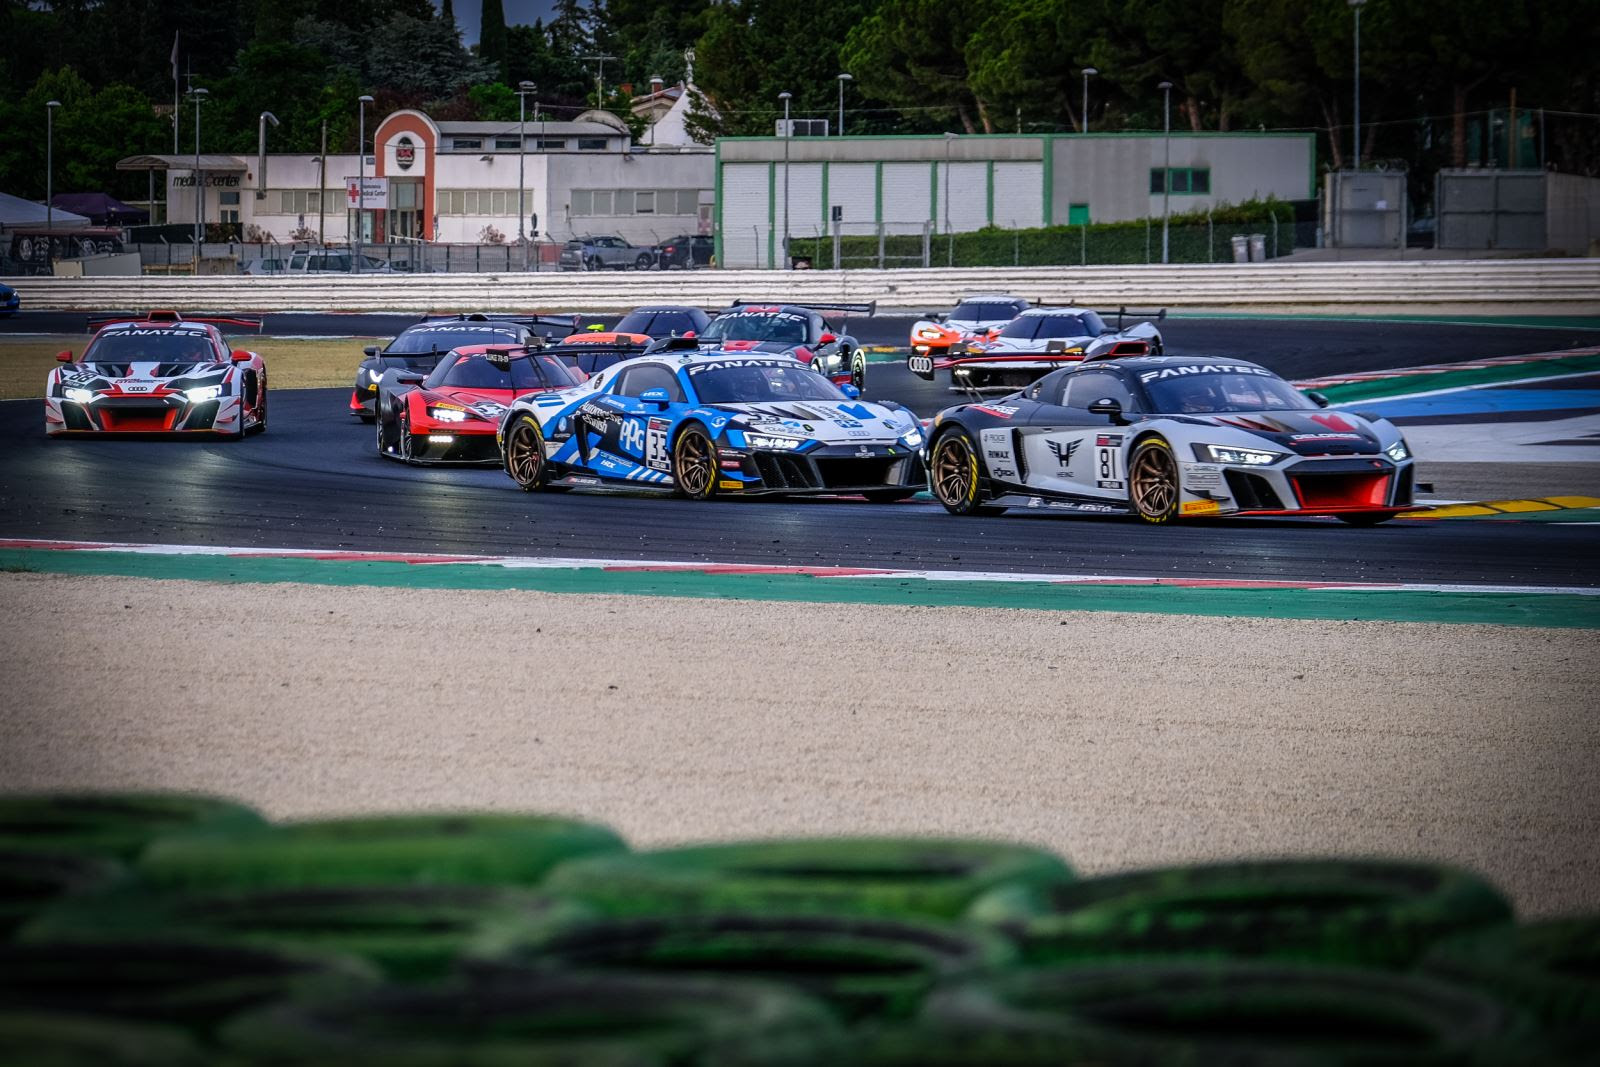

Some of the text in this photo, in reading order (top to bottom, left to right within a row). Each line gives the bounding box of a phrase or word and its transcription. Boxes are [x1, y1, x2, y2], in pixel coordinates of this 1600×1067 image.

[715, 312, 803, 322] FANATEC
[102, 329, 202, 338] FANATEC
[409, 326, 509, 334] FANATEC
[689, 360, 810, 376] FANATEC
[1140, 365, 1271, 383] FANATEC
[620, 418, 645, 451] PPG
[1100, 448, 1117, 479] 81
